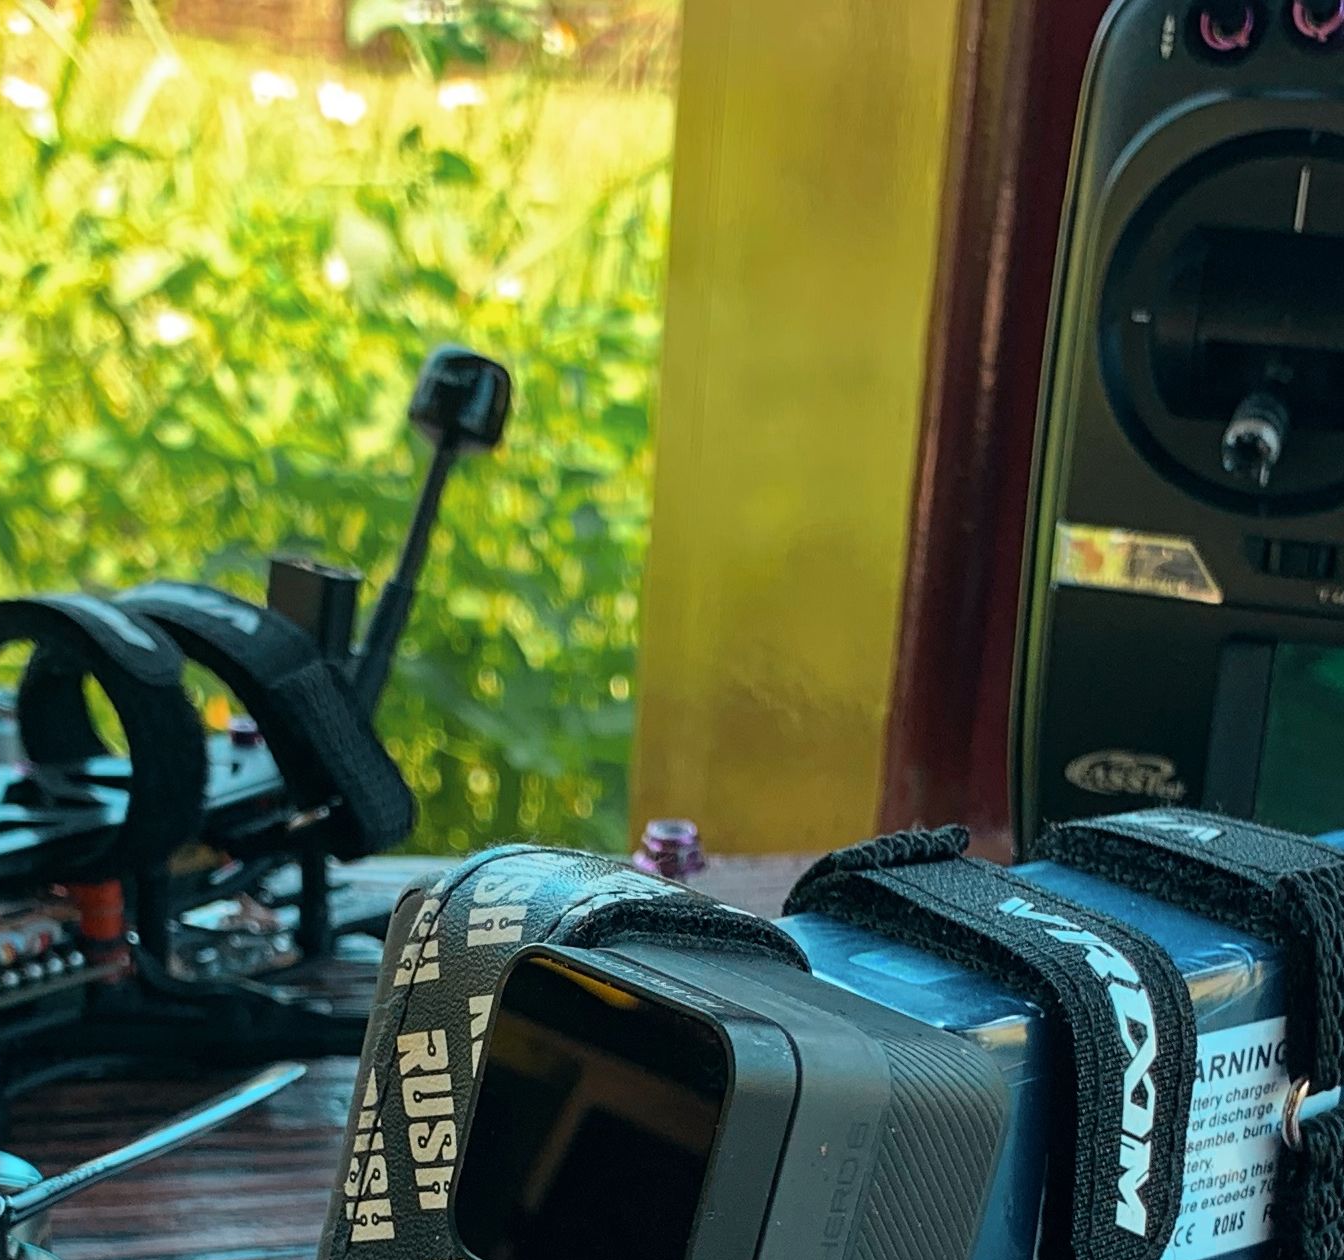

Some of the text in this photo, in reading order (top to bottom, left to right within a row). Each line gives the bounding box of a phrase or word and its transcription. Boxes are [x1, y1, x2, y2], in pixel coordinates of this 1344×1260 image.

[1191, 1080, 1279, 1113] ttery charger.
[396, 1028, 458, 1211] RUSH
[1208, 1102, 1278, 1129] discharge.
[1186, 1131, 1239, 1154] semble,
[1242, 1121, 1273, 1140] burn
[1186, 1157, 1215, 1175] tery.
[1189, 1167, 1248, 1194] charging
[1200, 1184, 1256, 1208] exceeds
